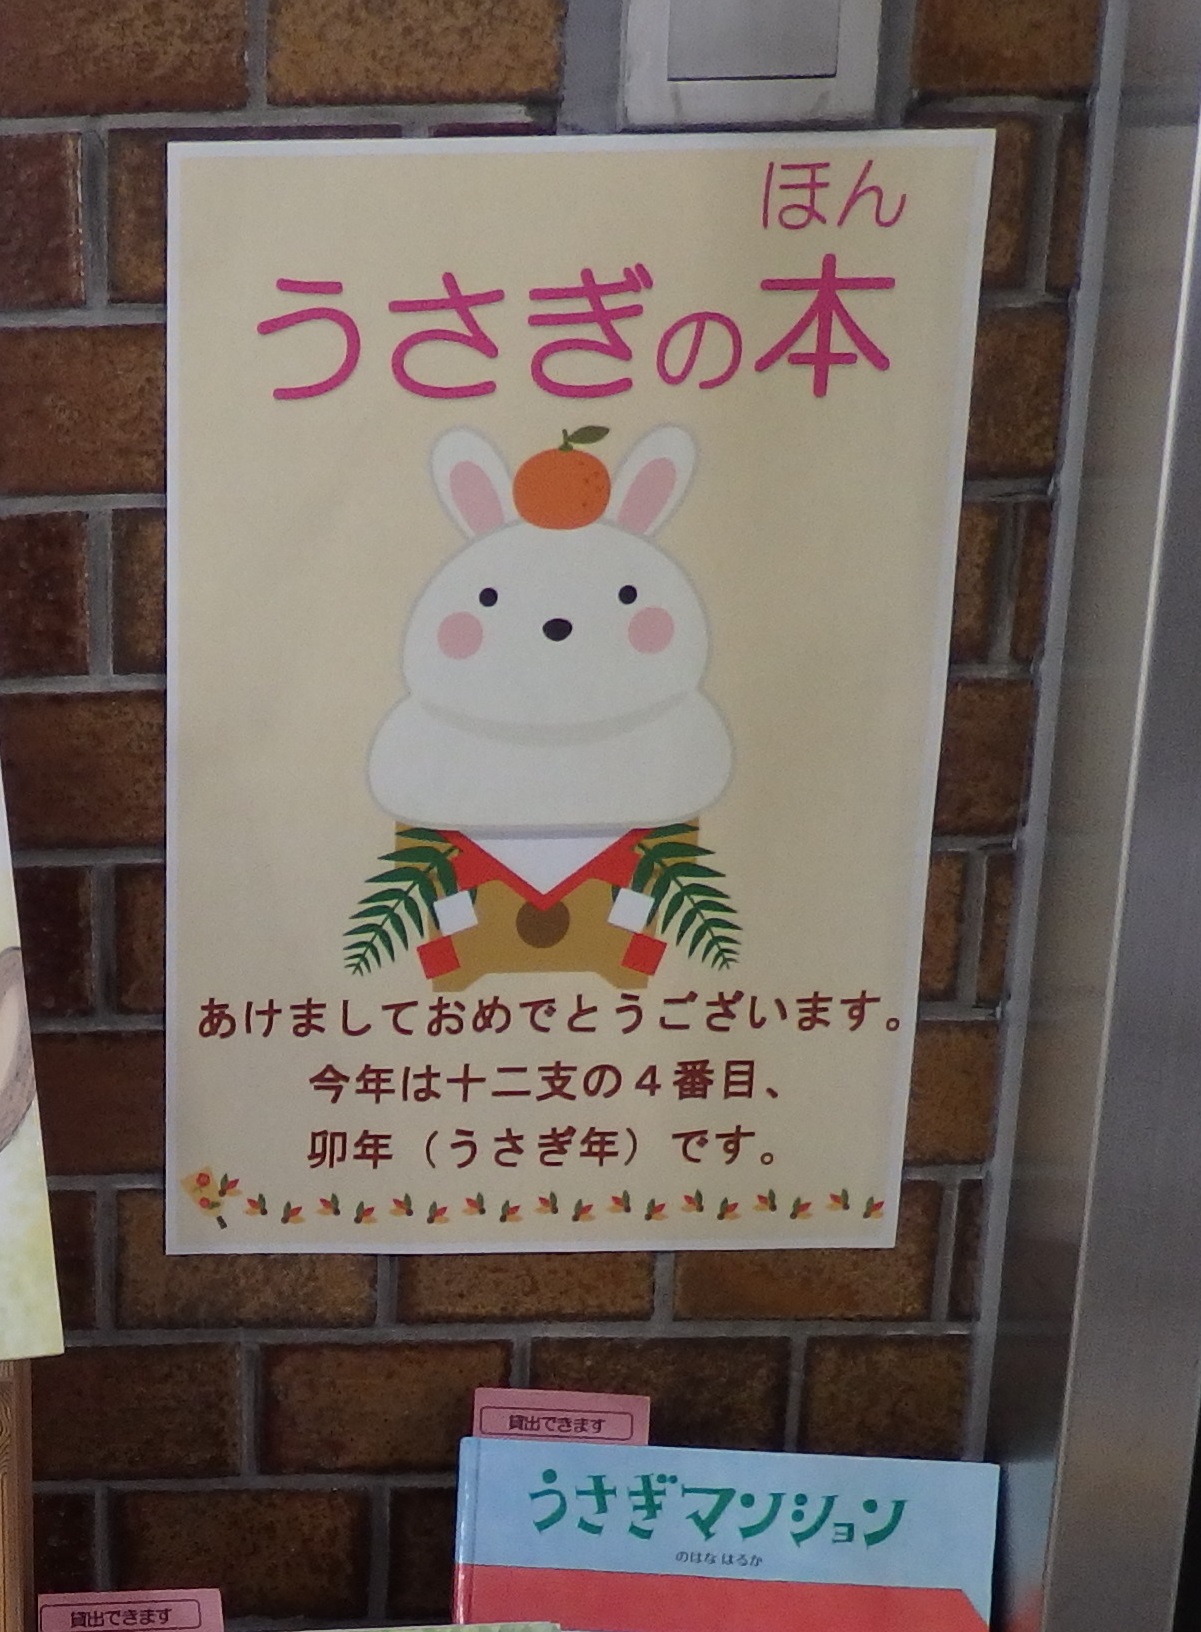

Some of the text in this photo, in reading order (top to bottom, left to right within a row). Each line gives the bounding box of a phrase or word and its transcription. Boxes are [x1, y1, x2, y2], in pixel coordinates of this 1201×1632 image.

[762, 159, 907, 230] ほん
[256, 252, 897, 401] うさぎの本
[198, 990, 903, 1040] あけましておめでとうございます。
[308, 1057, 783, 1106] 今年は十二支の4番目、
[307, 1124, 783, 1170] 卯年（うさぎ年）です。
[509, 1413, 607, 1435] 貸出できます
[528, 1468, 908, 1549] うさぎマンション
[676, 1550, 764, 1568] のはな はるか
[70, 1608, 173, 1629] 貸出できます
